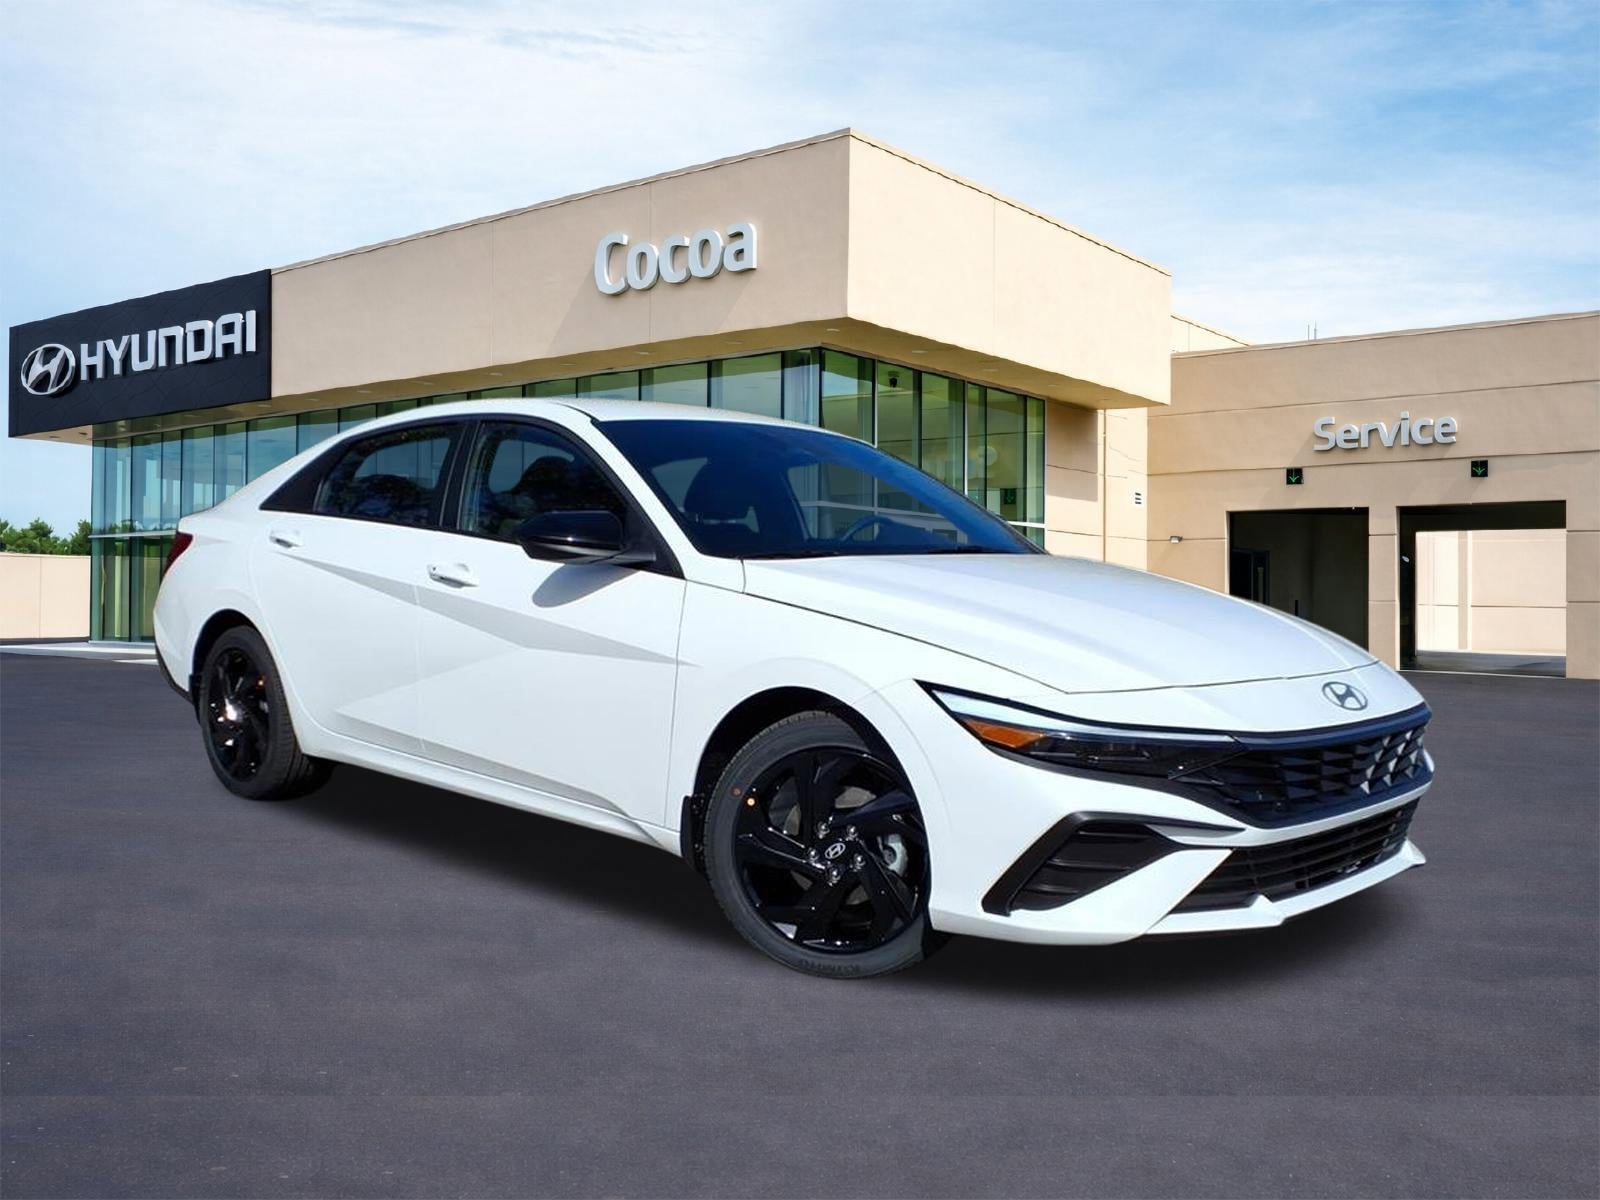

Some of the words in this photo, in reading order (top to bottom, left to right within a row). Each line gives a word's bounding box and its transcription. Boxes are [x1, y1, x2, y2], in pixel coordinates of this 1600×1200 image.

[594, 222, 758, 295] Cocoa
[80, 310, 257, 381] HYUNDAI
[1313, 411, 1458, 451] Service
